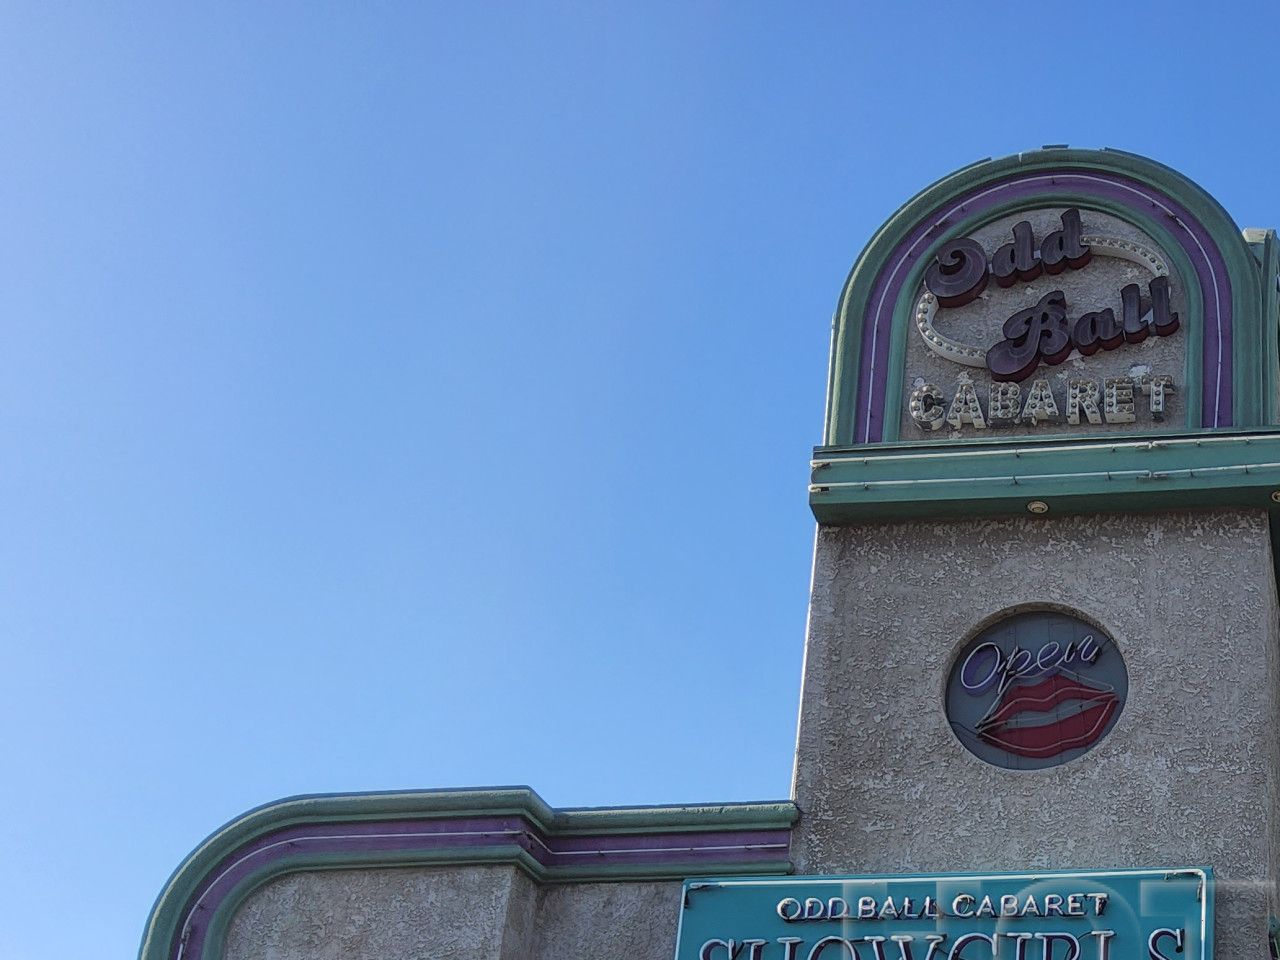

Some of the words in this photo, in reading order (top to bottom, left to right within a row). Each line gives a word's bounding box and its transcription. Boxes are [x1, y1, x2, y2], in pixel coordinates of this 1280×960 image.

[924, 207, 1091, 308] Odd
[986, 276, 1180, 384] Ball
[909, 375, 1176, 431] CABARET
[960, 635, 1102, 694] Open
[776, 895, 848, 922] ODD
[857, 894, 940, 920] BALL
[951, 892, 1110, 920] CABARET
